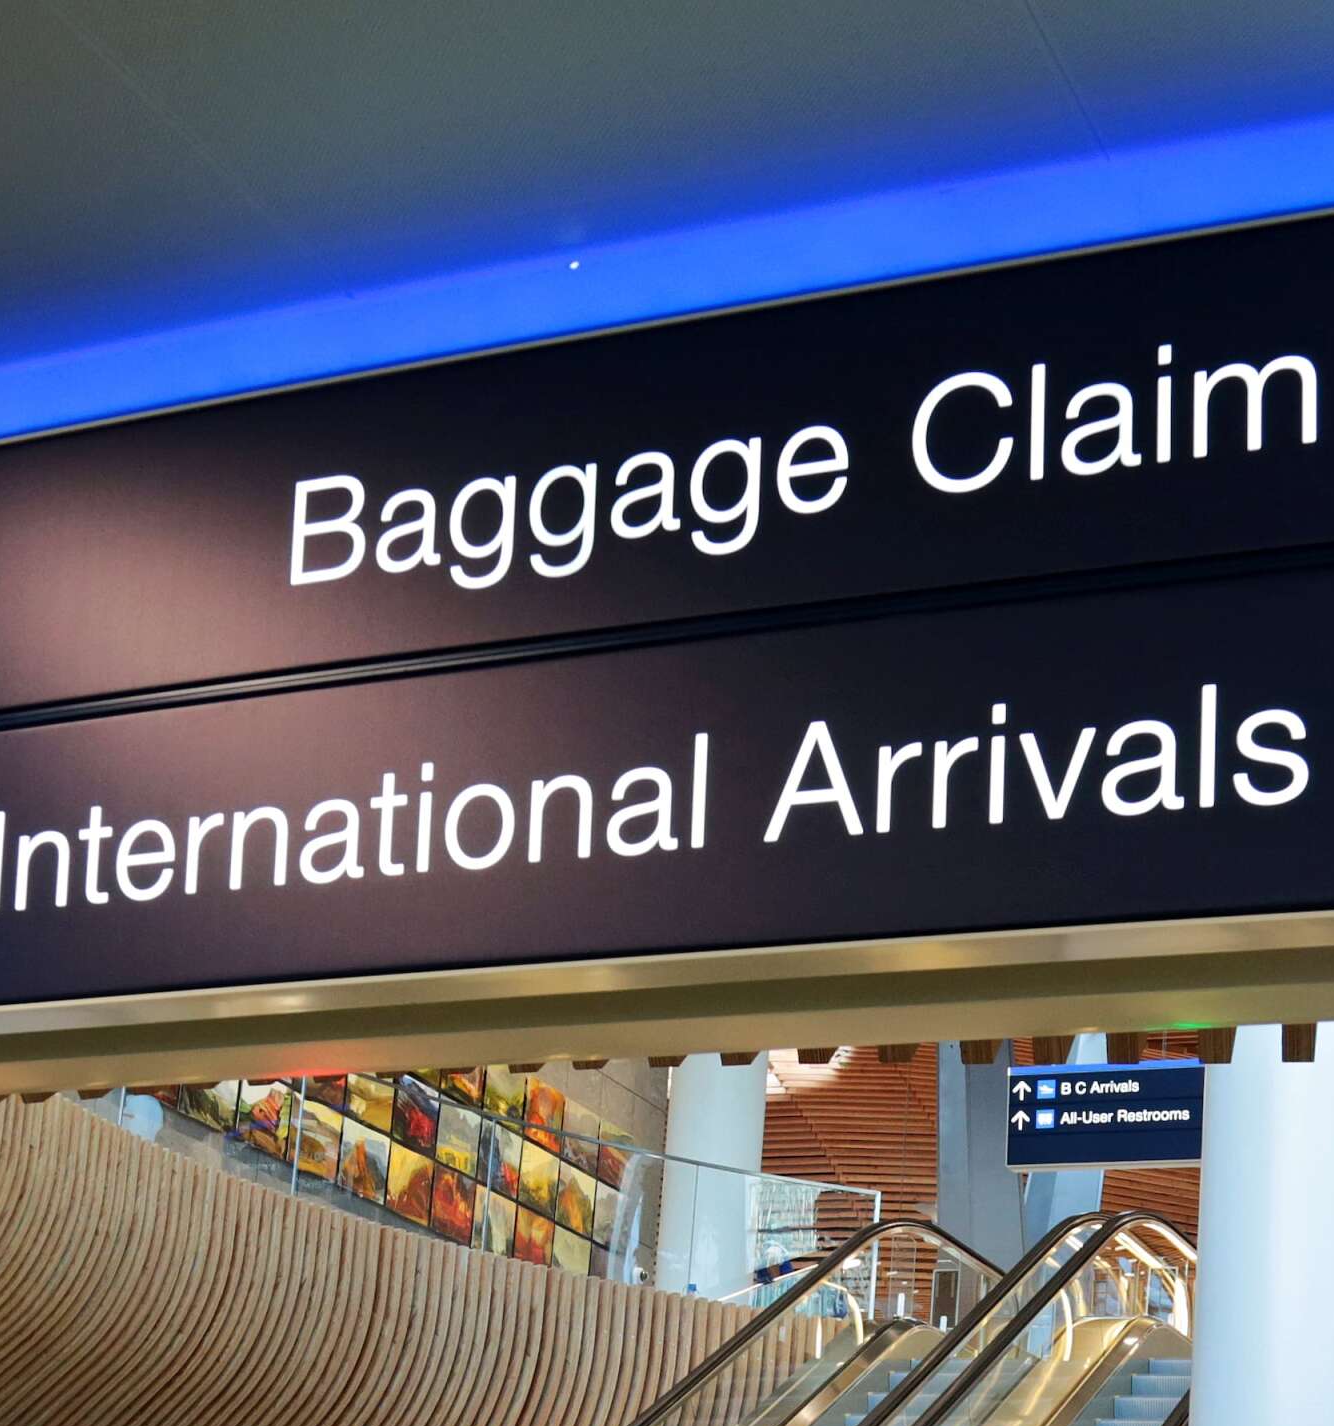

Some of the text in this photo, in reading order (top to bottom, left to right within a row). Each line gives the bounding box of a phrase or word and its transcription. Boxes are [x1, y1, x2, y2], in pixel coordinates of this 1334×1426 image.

[289, 344, 1318, 590] Baggage Claim
[763, 683, 1310, 843] Arrivals
[1060, 1079, 1140, 1095] B C Arrivals
[1060, 1108, 1190, 1125] All-User Restrooms
